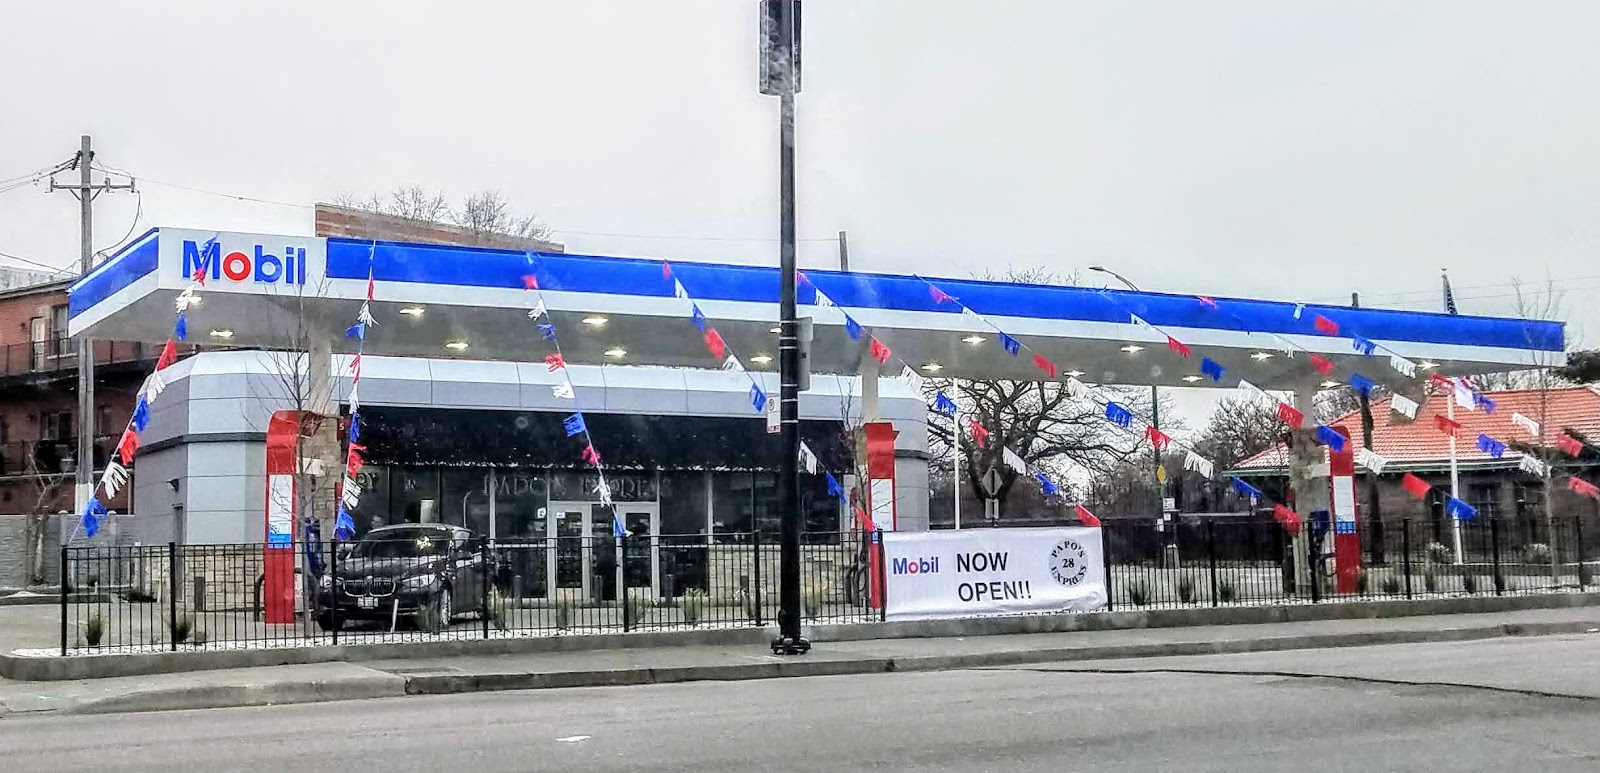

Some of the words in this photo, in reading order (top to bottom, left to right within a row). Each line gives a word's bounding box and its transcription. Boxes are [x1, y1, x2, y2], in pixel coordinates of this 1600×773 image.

[182, 240, 306, 284] Mobil
[1051, 540, 1086, 558] PAPO'S
[893, 556, 939, 575] Mobil
[956, 552, 1008, 573] NOW
[1062, 558, 1075, 568] 28
[1051, 565, 1087, 586] EXPRESS
[958, 580, 1032, 602] OPEN!!
